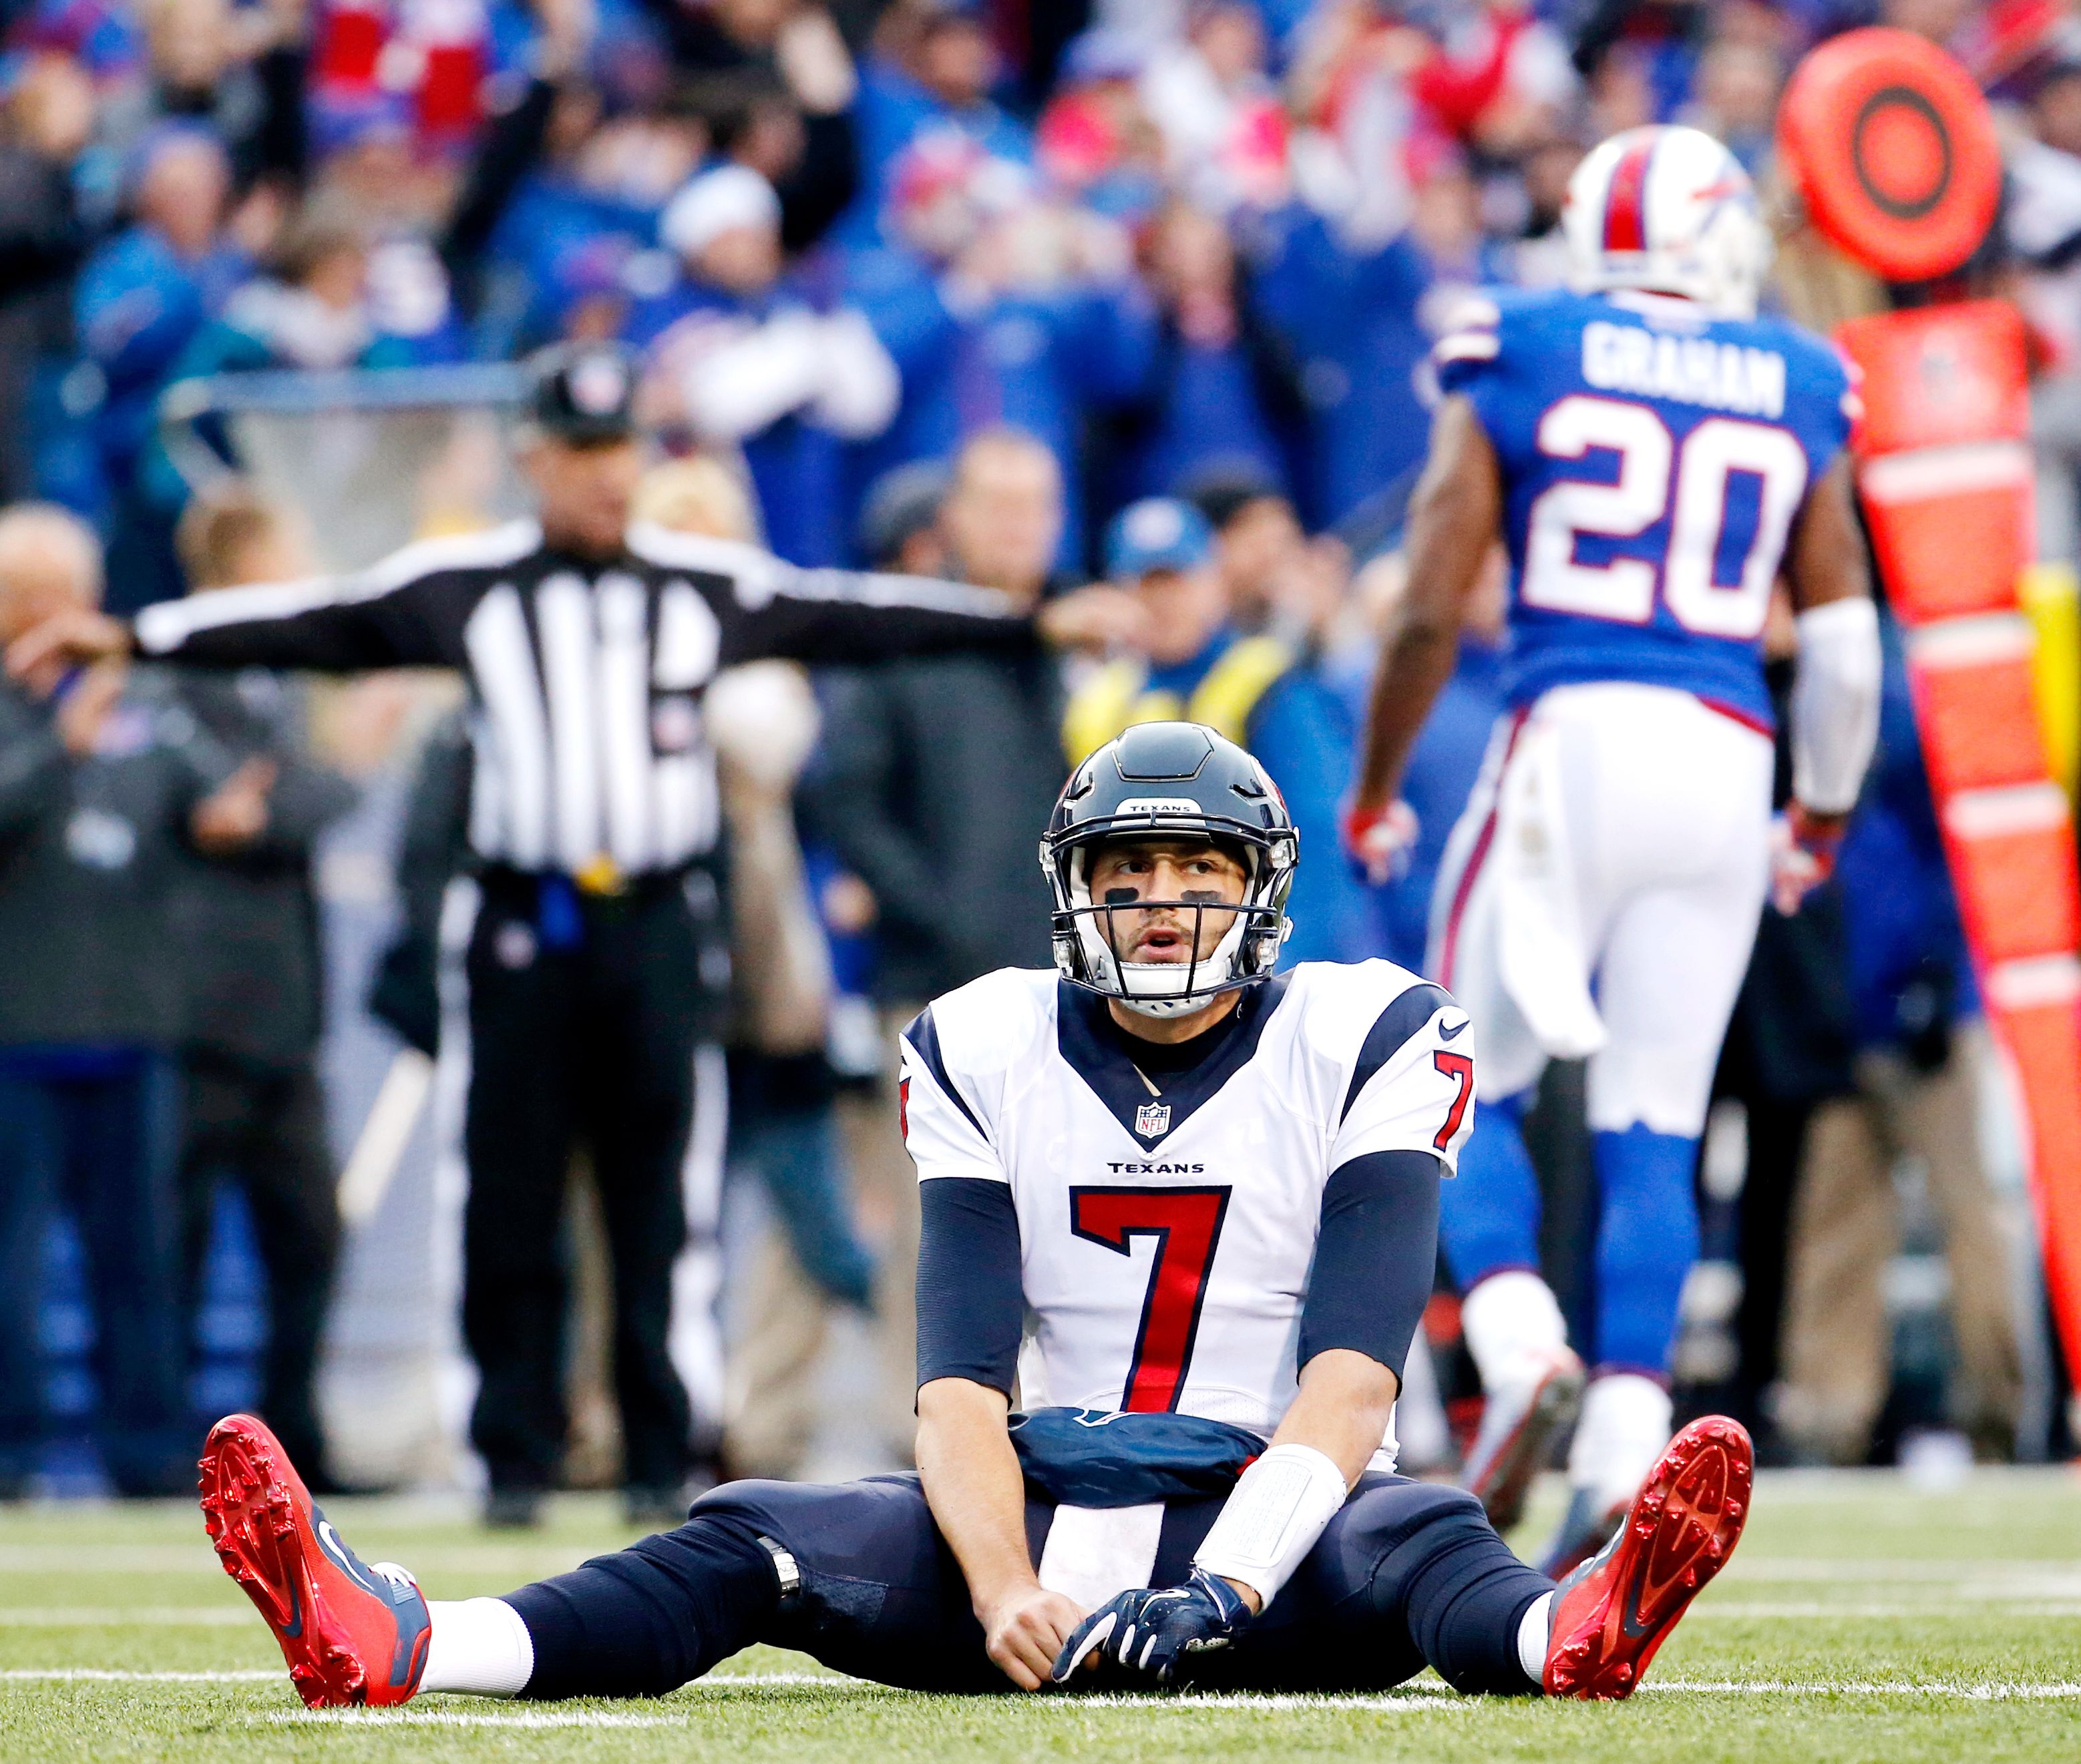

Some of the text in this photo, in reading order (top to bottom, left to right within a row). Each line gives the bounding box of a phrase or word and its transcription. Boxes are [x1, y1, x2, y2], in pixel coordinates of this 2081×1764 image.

[1582, 320, 1787, 419] GRAHAM
[1519, 393, 1808, 639] 20
[1141, 1118, 1162, 1132] NFL
[1433, 1050, 1473, 1153] 7
[1107, 1162, 1204, 1173] TEXANS
[1069, 1185, 1232, 1413] 7
